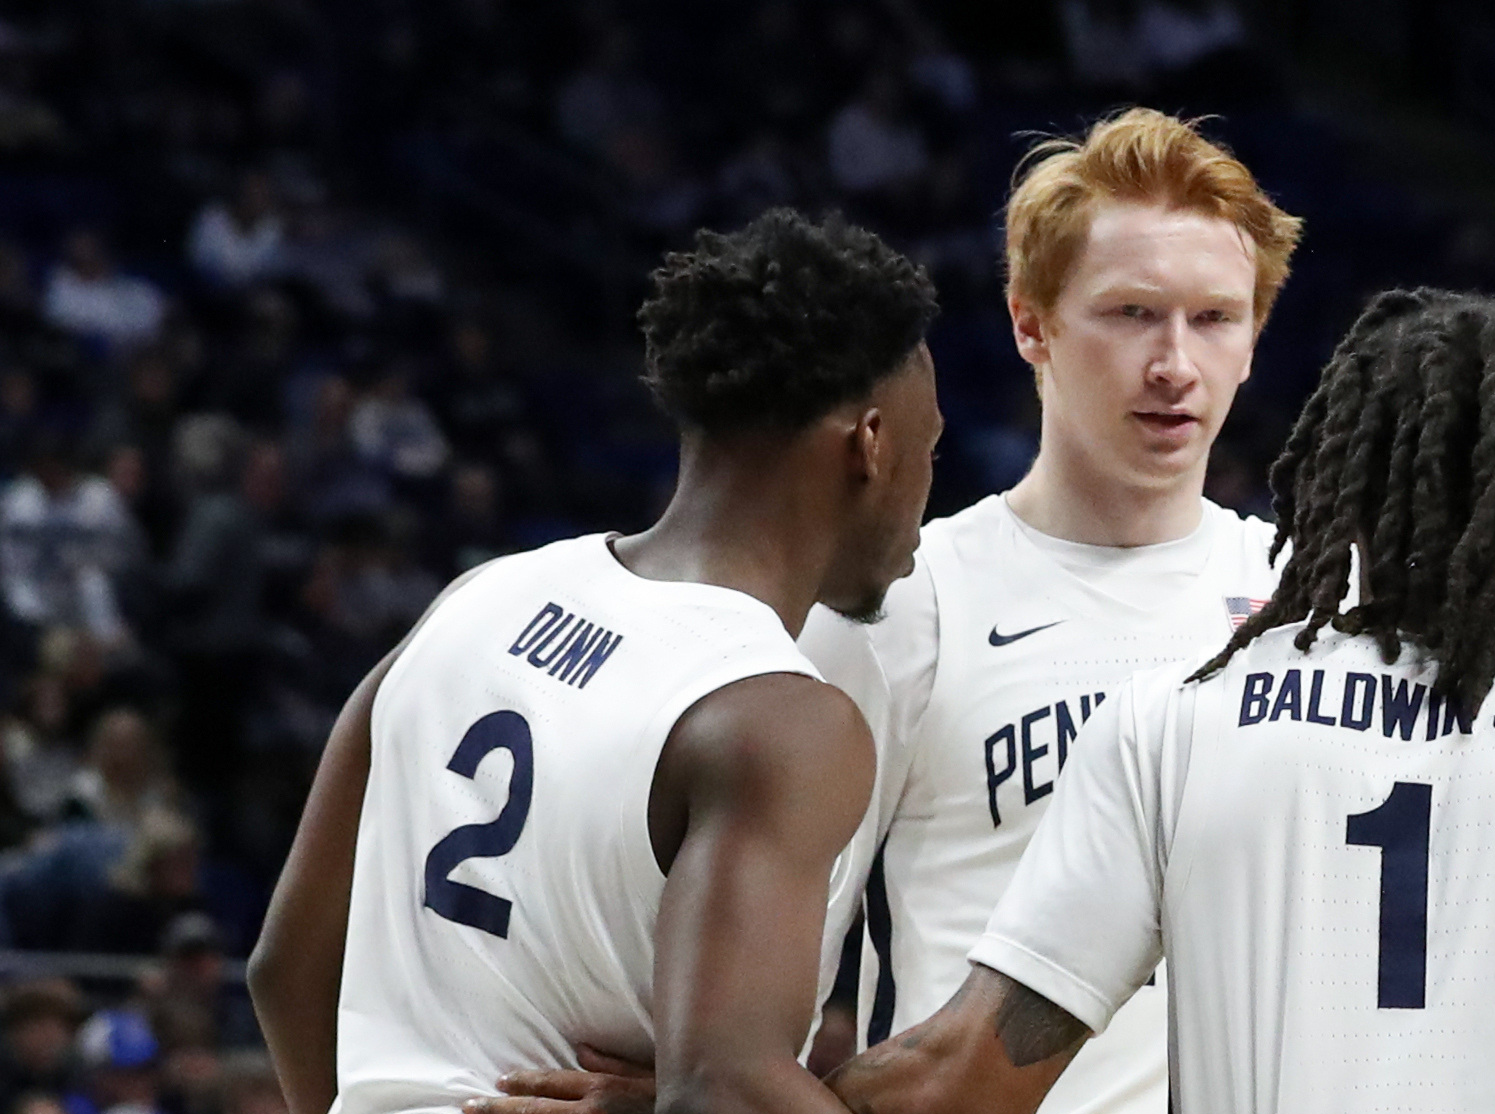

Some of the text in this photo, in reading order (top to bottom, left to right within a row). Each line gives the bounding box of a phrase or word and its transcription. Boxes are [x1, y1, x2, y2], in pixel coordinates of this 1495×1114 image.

[508, 602, 623, 689] DUNN
[424, 709, 534, 940] 2
[985, 692, 1106, 829] PEN
[1345, 781, 1433, 1009] 1
